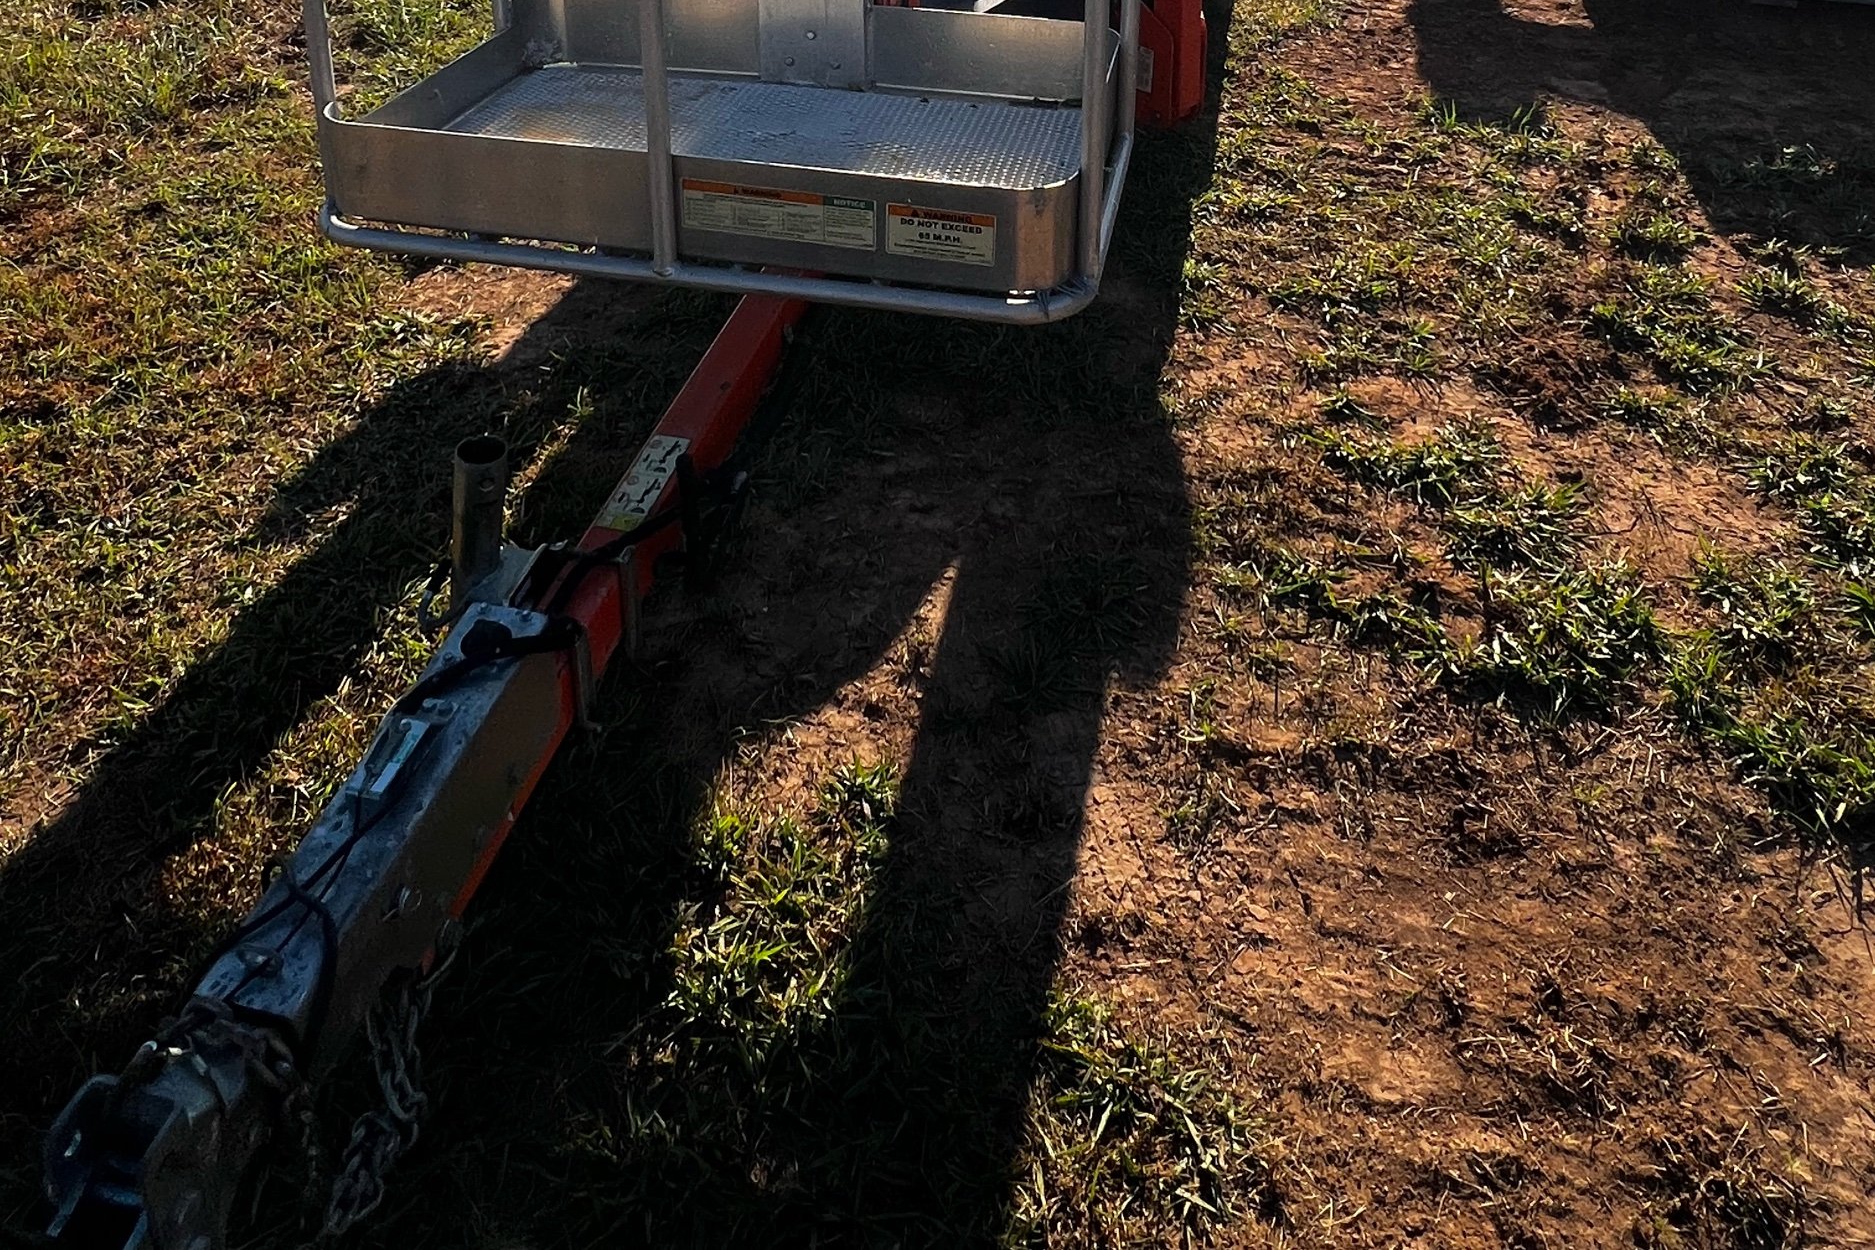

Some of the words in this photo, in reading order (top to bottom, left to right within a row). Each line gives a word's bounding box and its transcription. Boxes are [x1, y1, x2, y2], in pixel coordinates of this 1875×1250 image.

[833, 198, 866, 209] NOTICE
[923, 210, 973, 224] WARNING
[900, 217, 915, 226] DO
[917, 219, 938, 229] NOT
[941, 222, 983, 234] EXCEED
